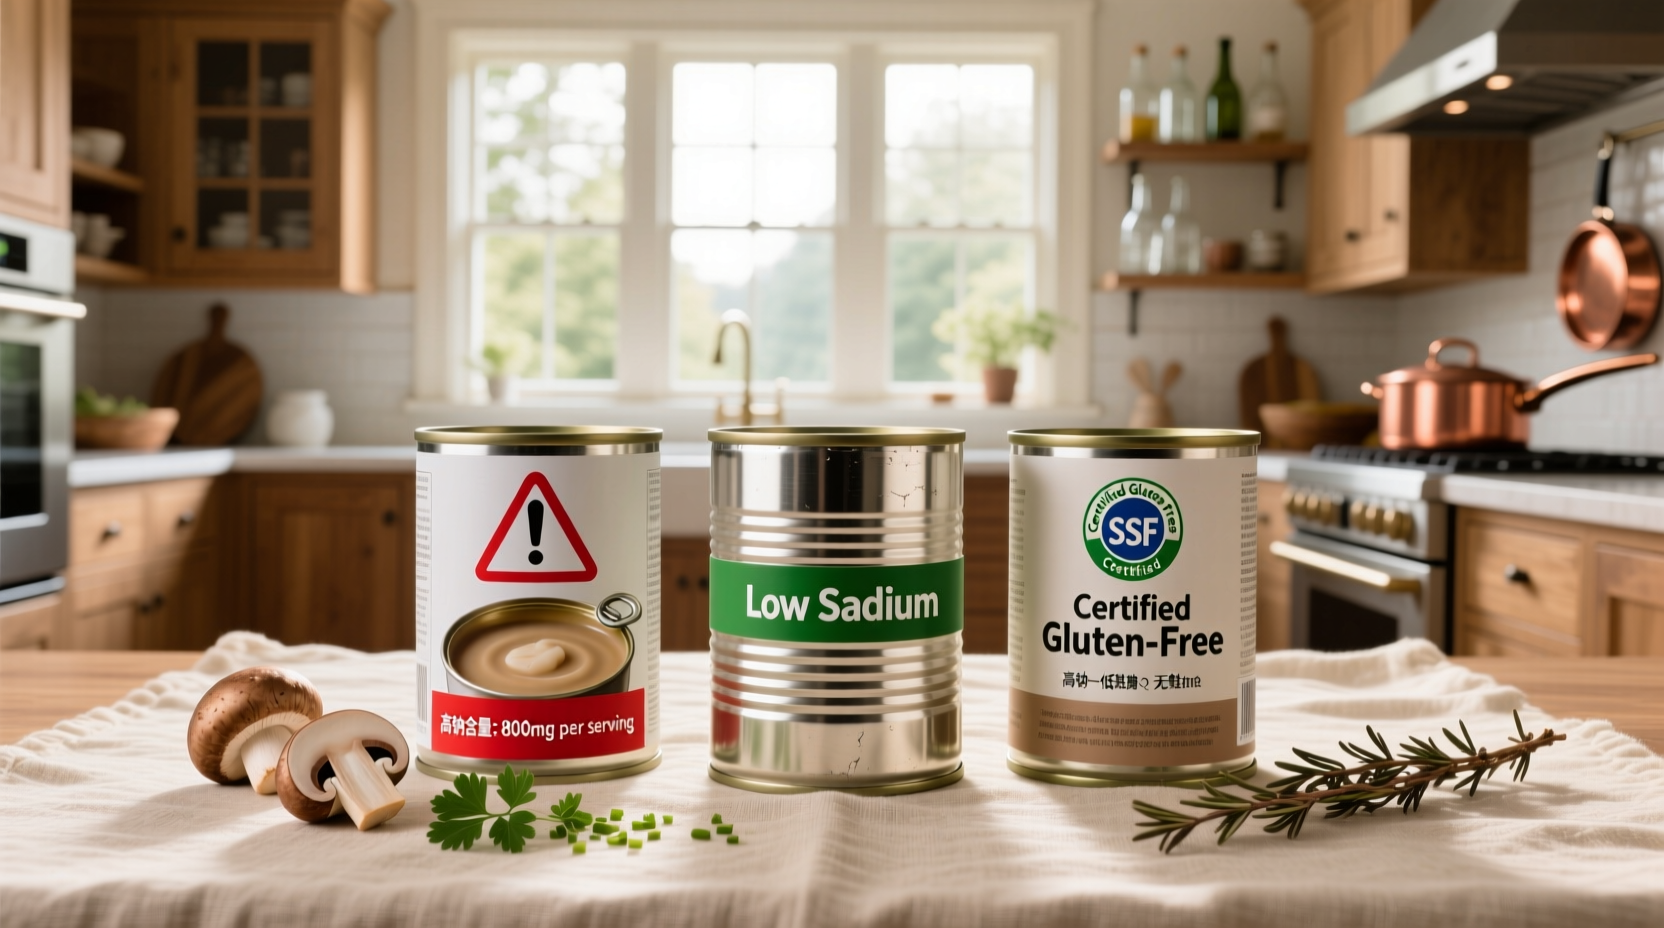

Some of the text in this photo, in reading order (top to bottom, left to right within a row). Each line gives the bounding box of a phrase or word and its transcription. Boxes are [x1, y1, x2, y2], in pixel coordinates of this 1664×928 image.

[1108, 516, 1159, 547] SSF
[746, 584, 939, 622] Low Sadium
[1073, 593, 1191, 621] Certified
[1042, 621, 1224, 657] Gluten-Free
[501, 720, 555, 742] 800mg
[559, 722, 585, 740] per
[587, 714, 635, 735] serving
